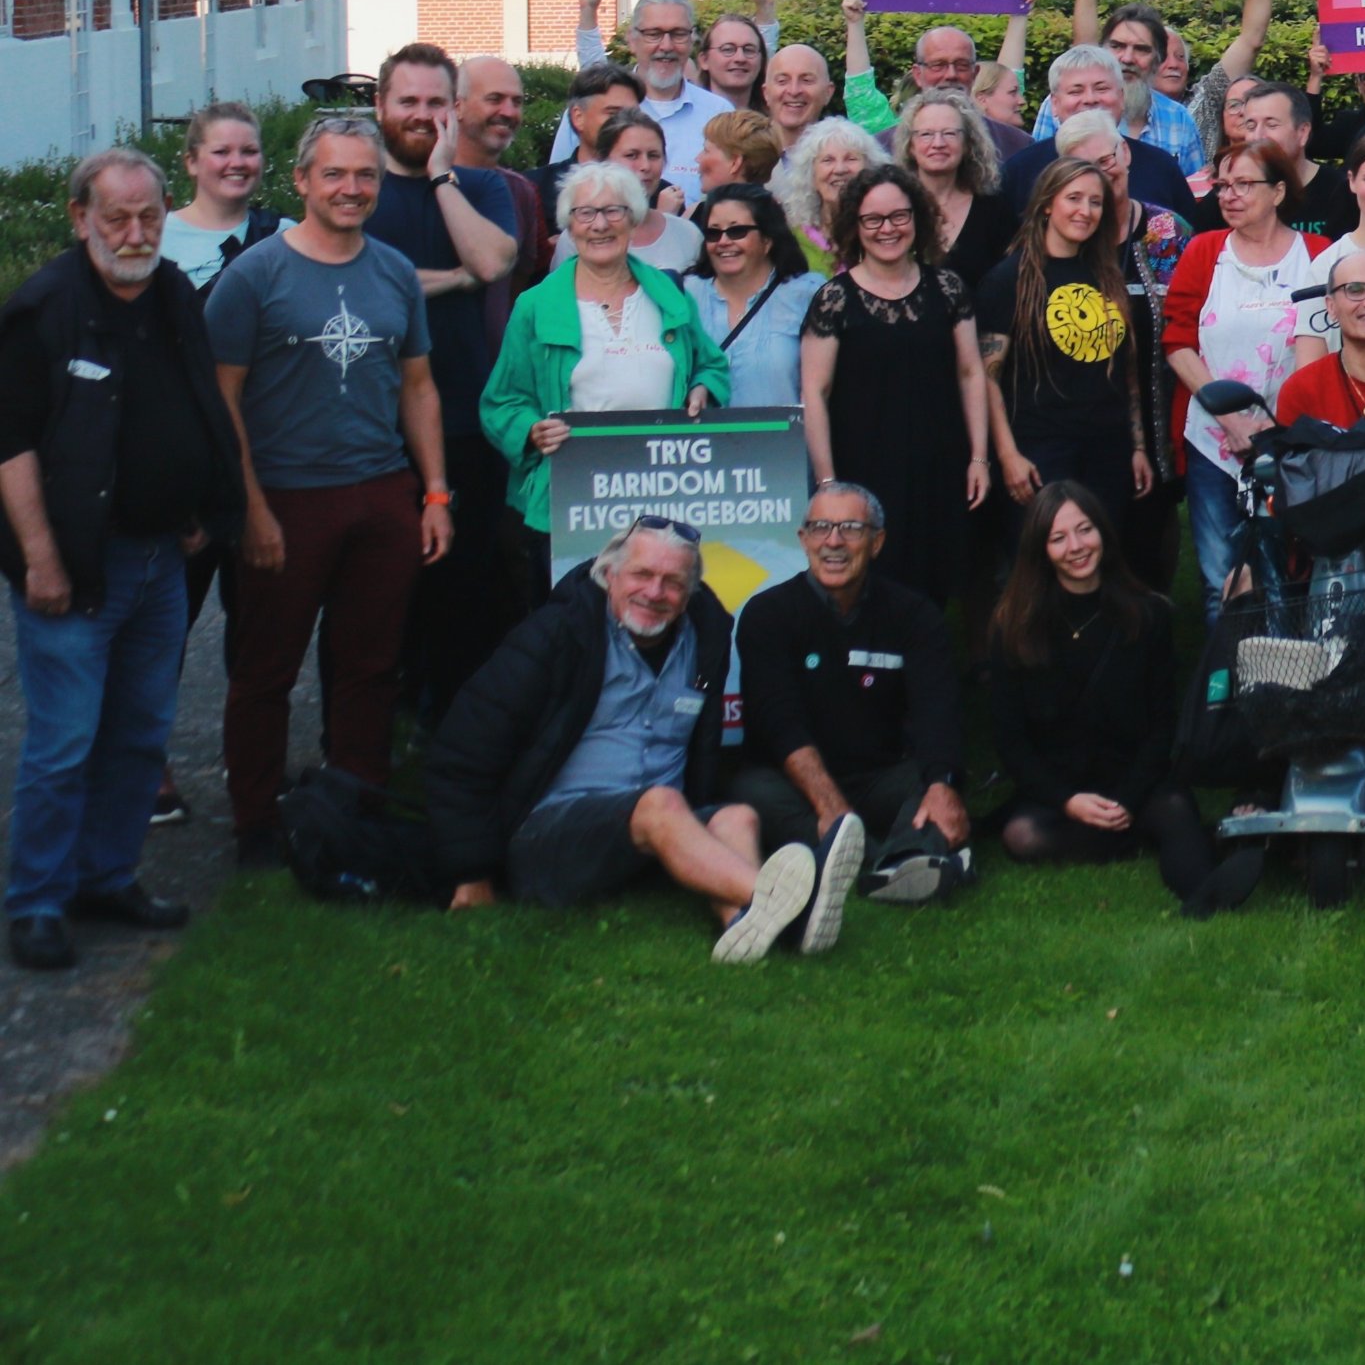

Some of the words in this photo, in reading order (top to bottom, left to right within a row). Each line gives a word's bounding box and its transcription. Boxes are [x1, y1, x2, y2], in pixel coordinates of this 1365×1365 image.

[647, 439, 711, 465] TRYG
[594, 470, 724, 498] BARNDOM
[732, 469, 766, 493] TIL
